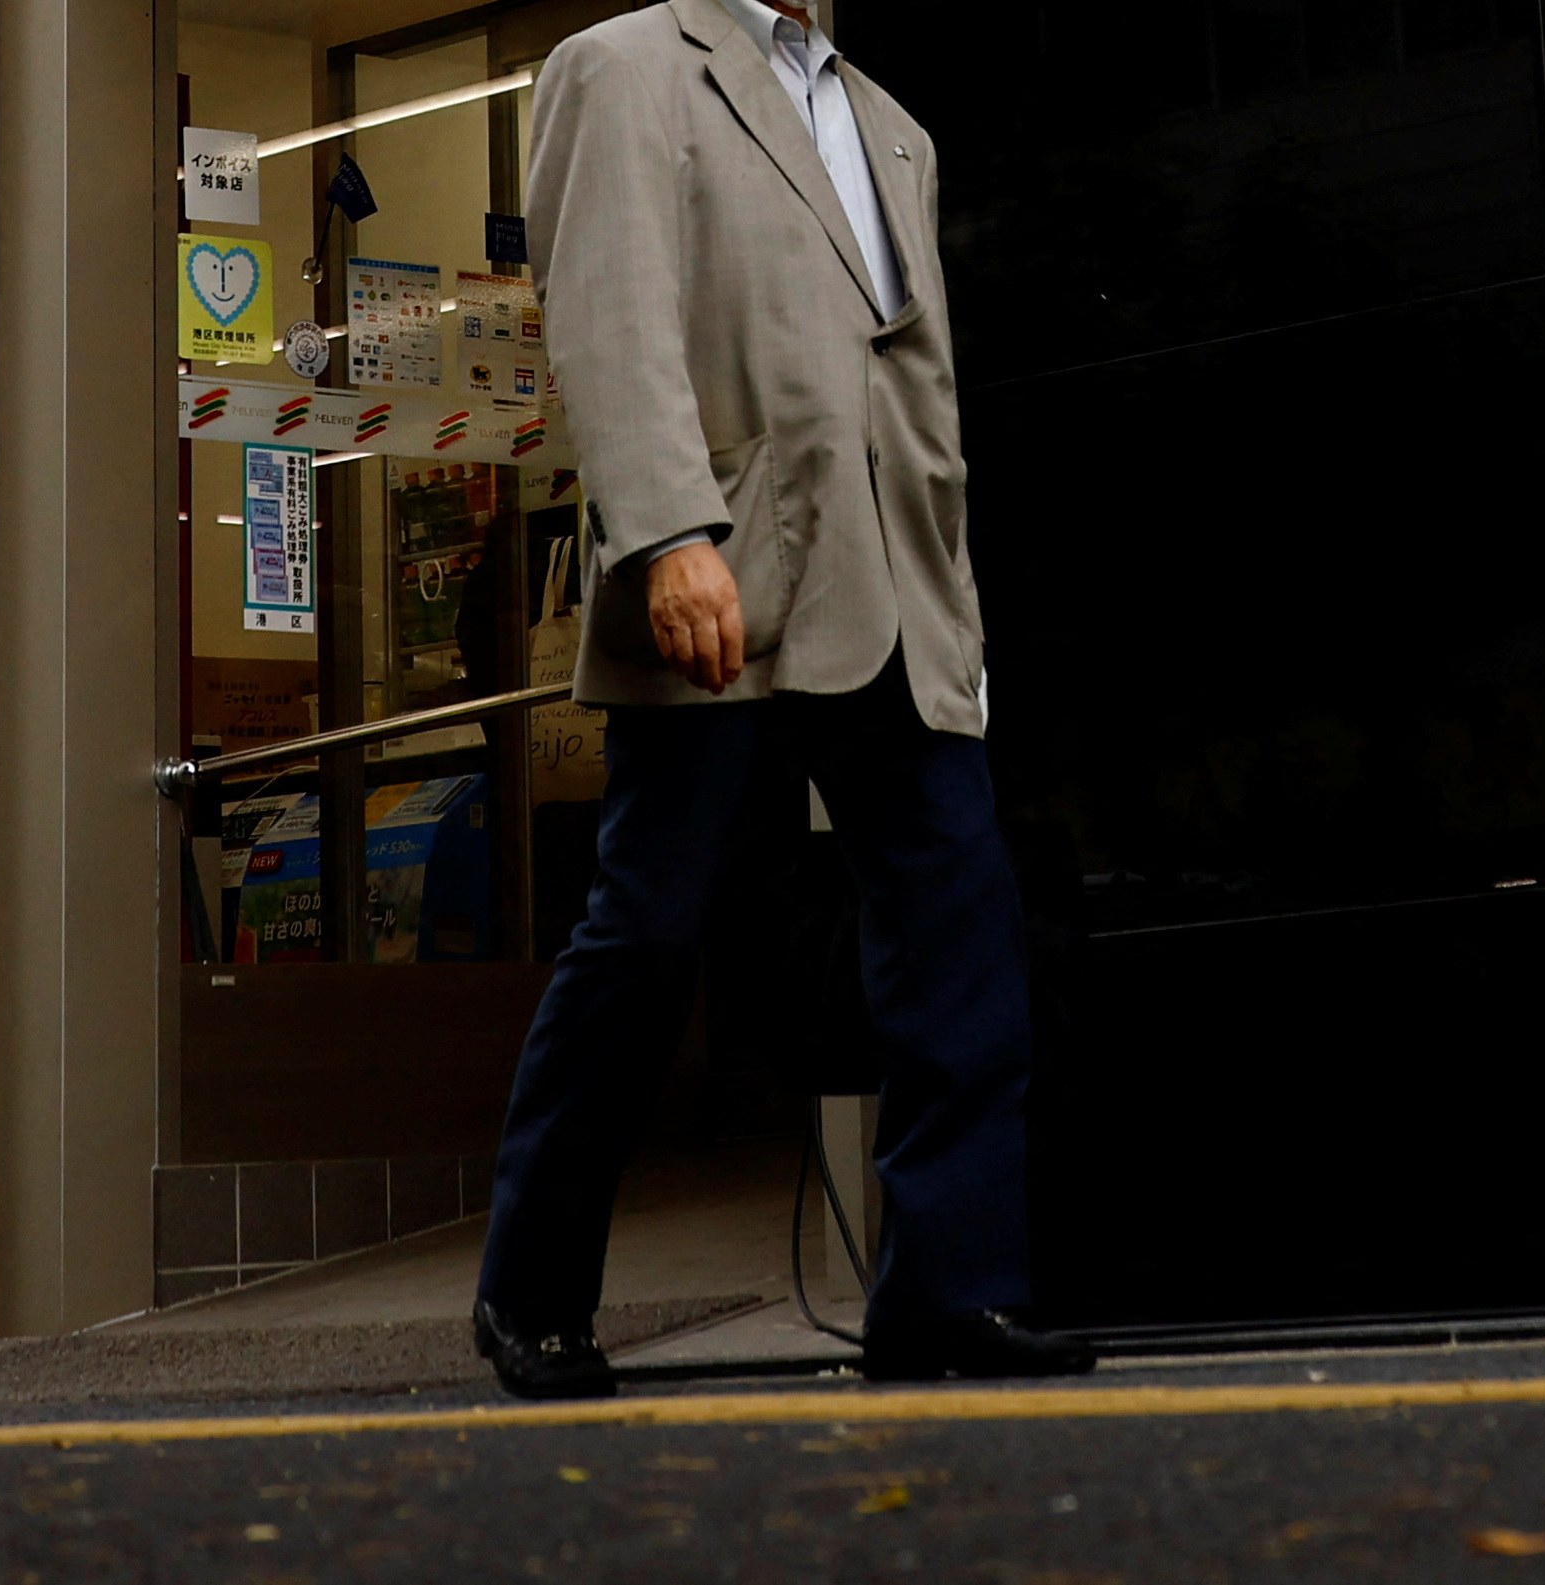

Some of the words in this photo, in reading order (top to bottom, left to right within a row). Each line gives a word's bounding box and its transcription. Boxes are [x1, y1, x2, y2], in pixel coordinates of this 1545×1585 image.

[191, 153, 253, 173] インボイス
[201, 173, 244, 191] 対象店
[193, 328, 256, 344] 港区喫煙場所
[251, 853, 279, 869] NEW
